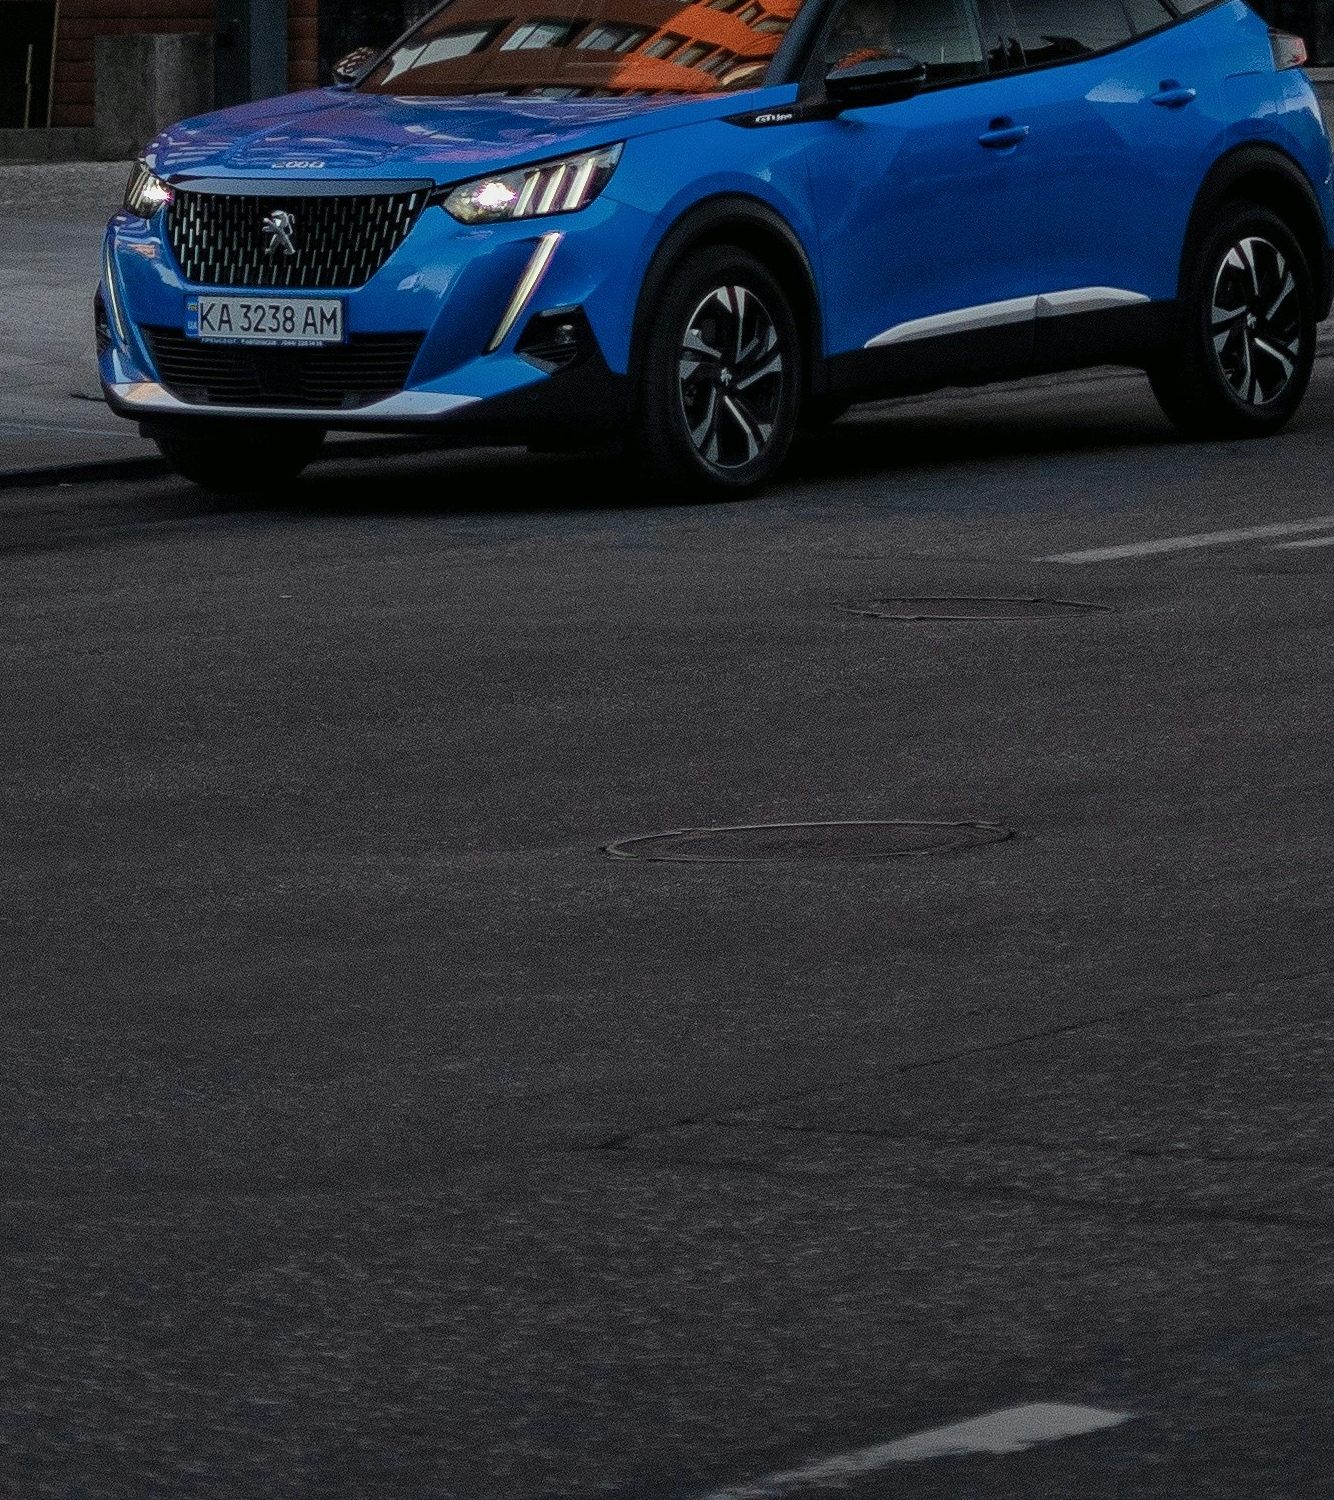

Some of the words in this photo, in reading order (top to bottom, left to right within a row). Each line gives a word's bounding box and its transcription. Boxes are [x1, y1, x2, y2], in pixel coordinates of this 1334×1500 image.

[199, 302, 233, 332] KA
[239, 304, 296, 334] 3238
[302, 306, 338, 336] AM
